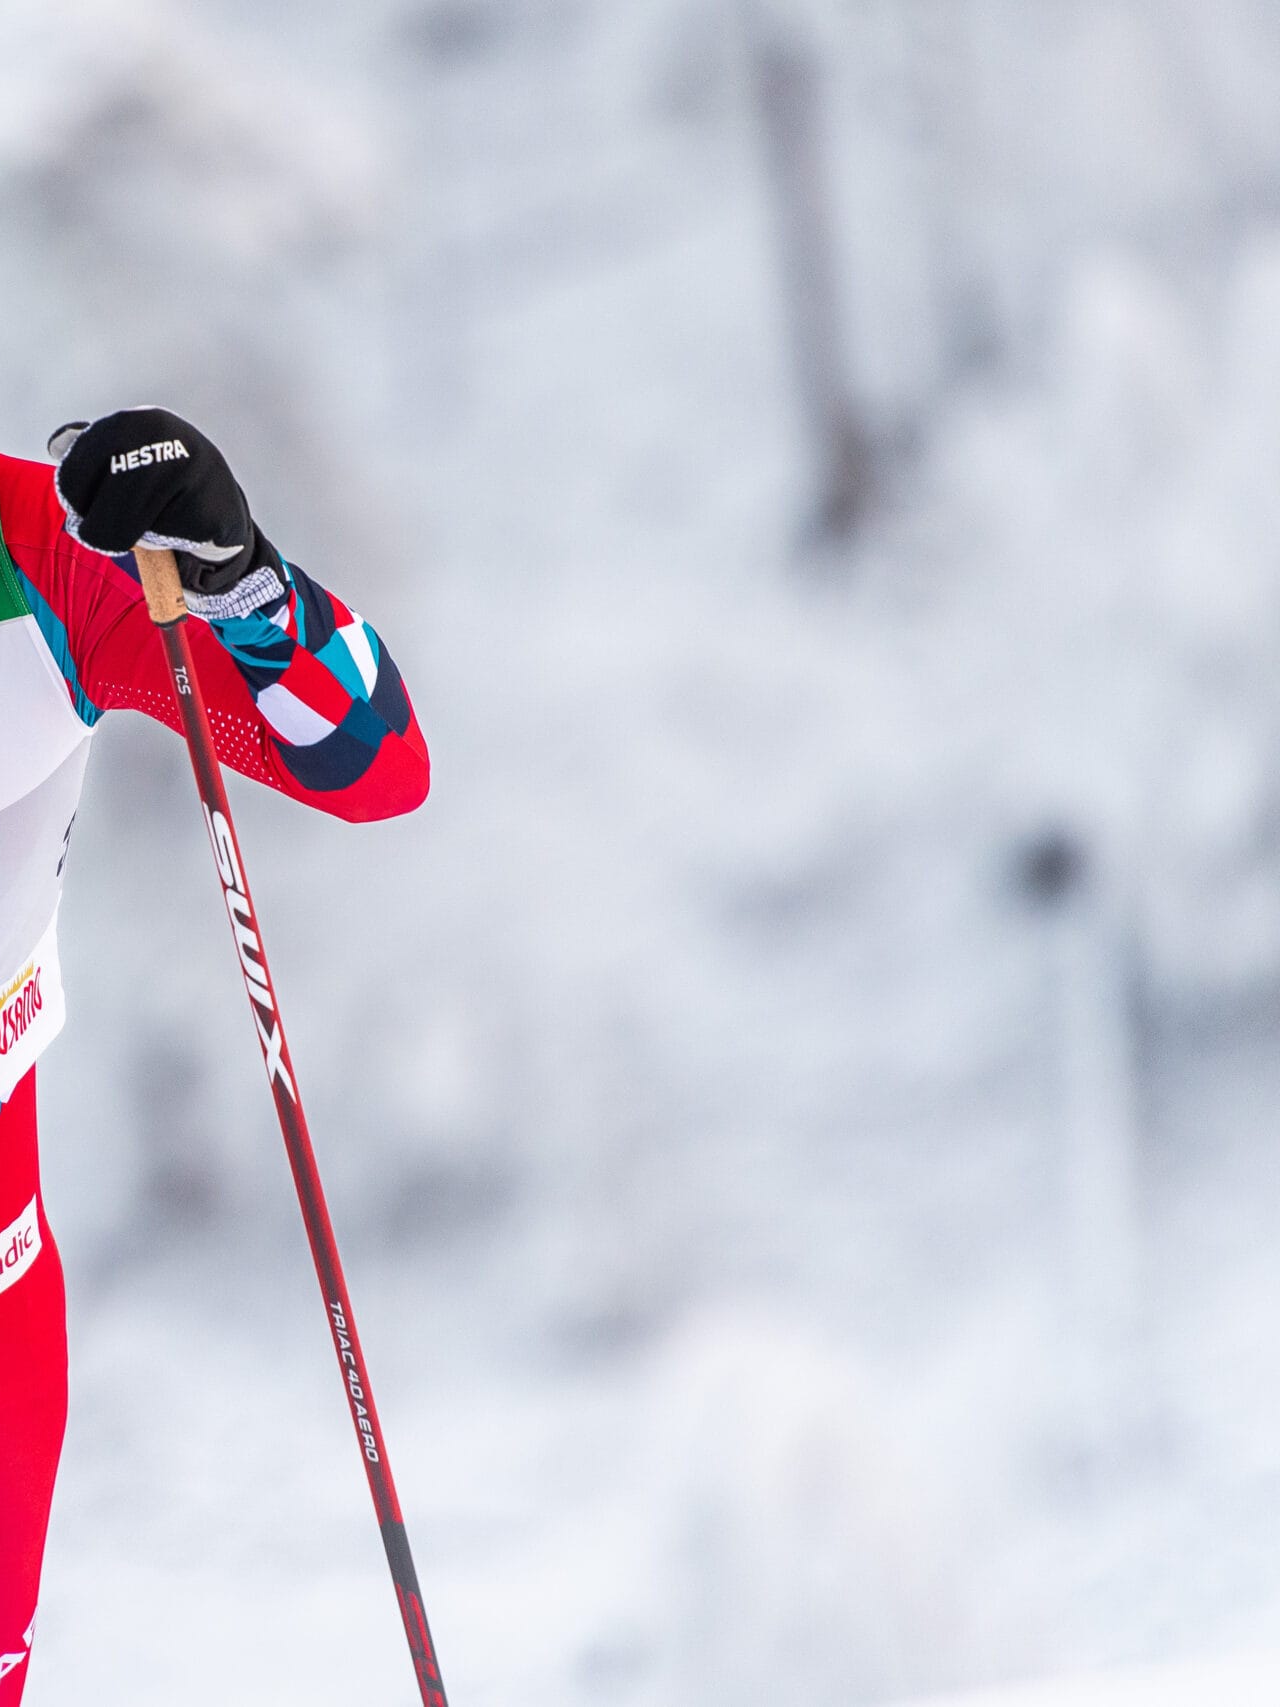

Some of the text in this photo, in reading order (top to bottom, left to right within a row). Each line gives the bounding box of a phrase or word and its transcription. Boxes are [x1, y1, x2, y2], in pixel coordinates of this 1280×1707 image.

[111, 439, 190, 474] HESTRA
[174, 665, 192, 695] TCS
[330, 1301, 357, 1366] TRIAC
[354, 1401, 380, 1463] AERO
